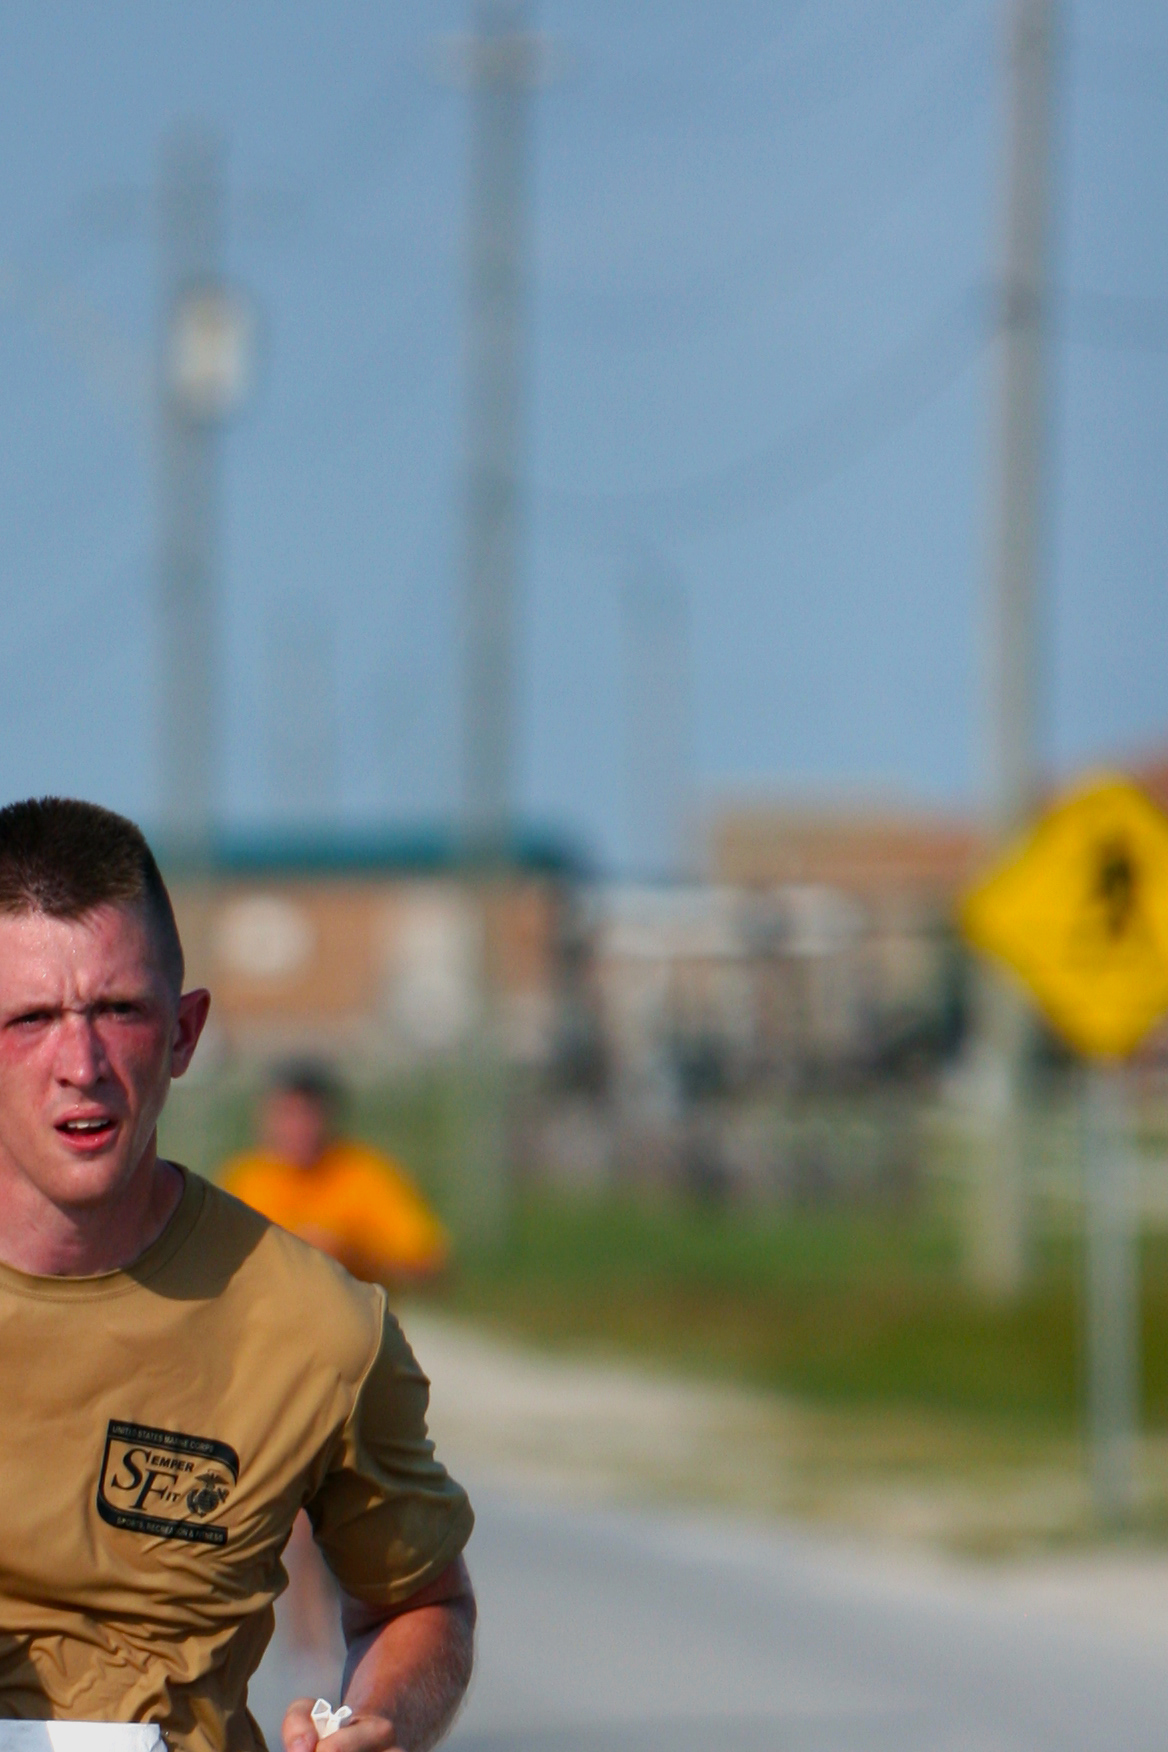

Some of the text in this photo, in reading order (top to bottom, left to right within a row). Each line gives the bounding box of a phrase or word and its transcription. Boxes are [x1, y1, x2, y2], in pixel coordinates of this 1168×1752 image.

[138, 1430, 163, 1443] STATES
[164, 1435, 188, 1448] MARE
[190, 1439, 214, 1453] CORPS
[146, 1521, 188, 1537] RECREAON
